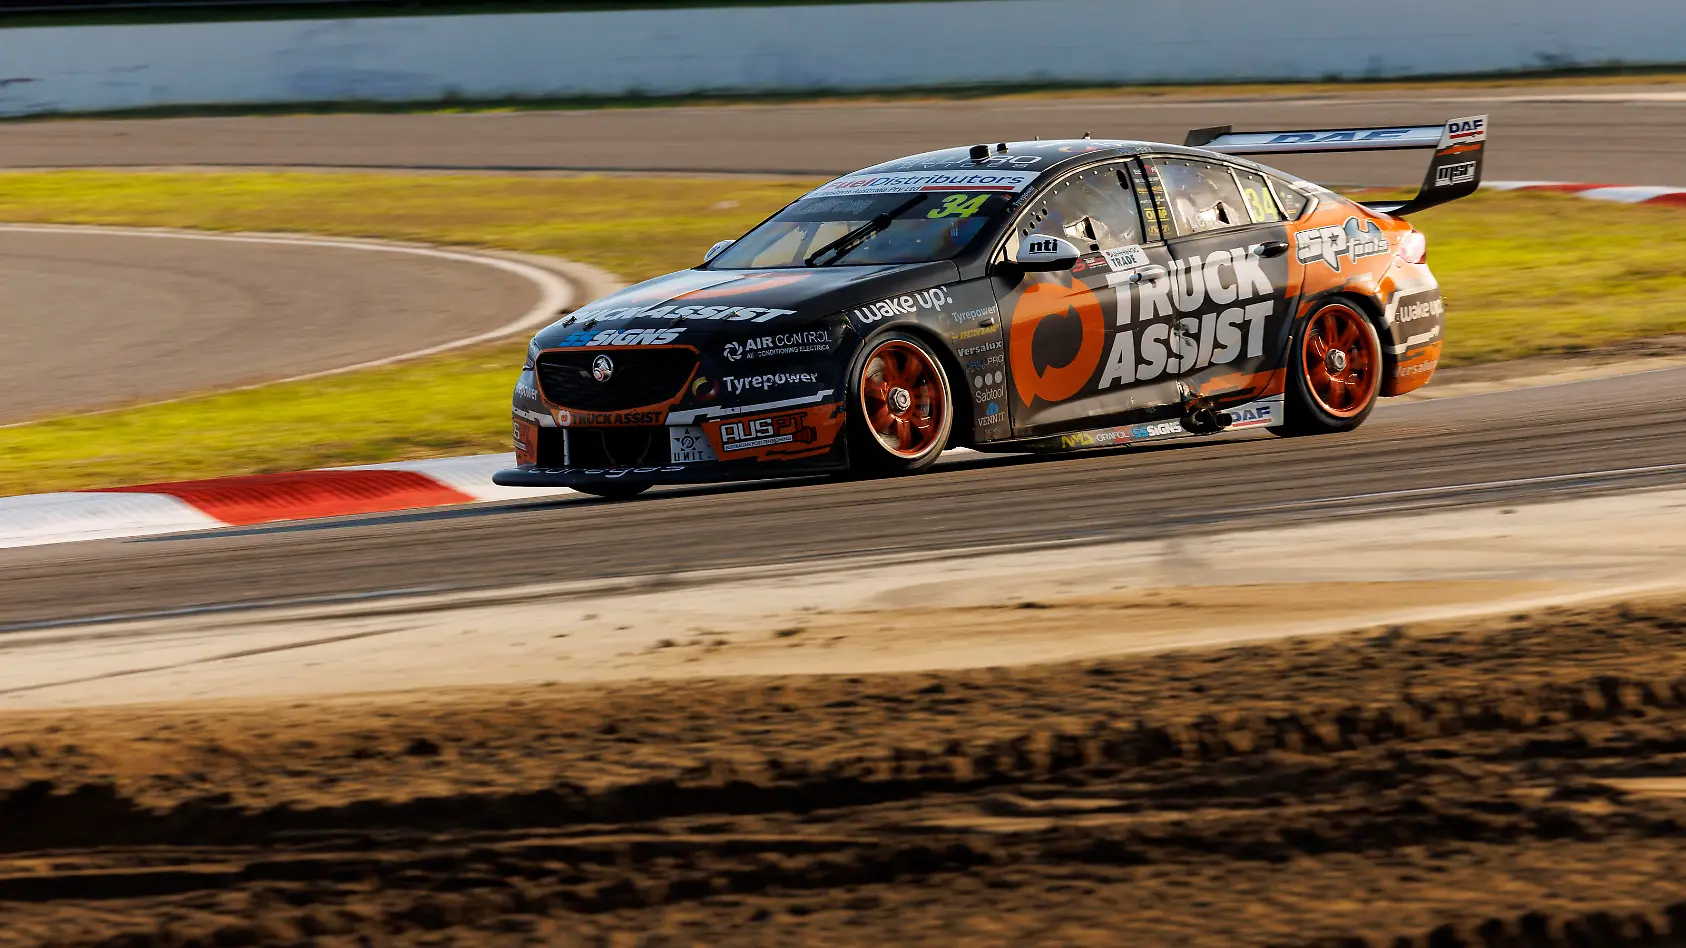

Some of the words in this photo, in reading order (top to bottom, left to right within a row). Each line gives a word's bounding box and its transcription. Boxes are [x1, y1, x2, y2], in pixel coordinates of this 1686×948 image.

[1447, 119, 1484, 134] DAF
[1267, 128, 1411, 145] DAF
[926, 193, 992, 219] 34
[1244, 186, 1279, 222] 34
[1028, 239, 1058, 252] nti
[1110, 254, 1138, 268] TRADE
[1105, 244, 1274, 327] TRUCK
[854, 293, 917, 325] wake
[951, 302, 1000, 323] Tyrepower
[1399, 301, 1430, 323] wake
[745, 336, 774, 351] AIR
[775, 329, 832, 346] CONTROL
[956, 339, 1003, 358] Versalux
[1098, 300, 1275, 390] ASSIST
[723, 372, 819, 395] Tyrepower
[975, 385, 1005, 404] Sabtool
[572, 412, 613, 426] TRUCK
[614, 411, 663, 424] ASSIST
[1231, 405, 1271, 423] DAF
[1096, 430, 1130, 443] ORAFOL
[673, 450, 704, 462] UNIT
